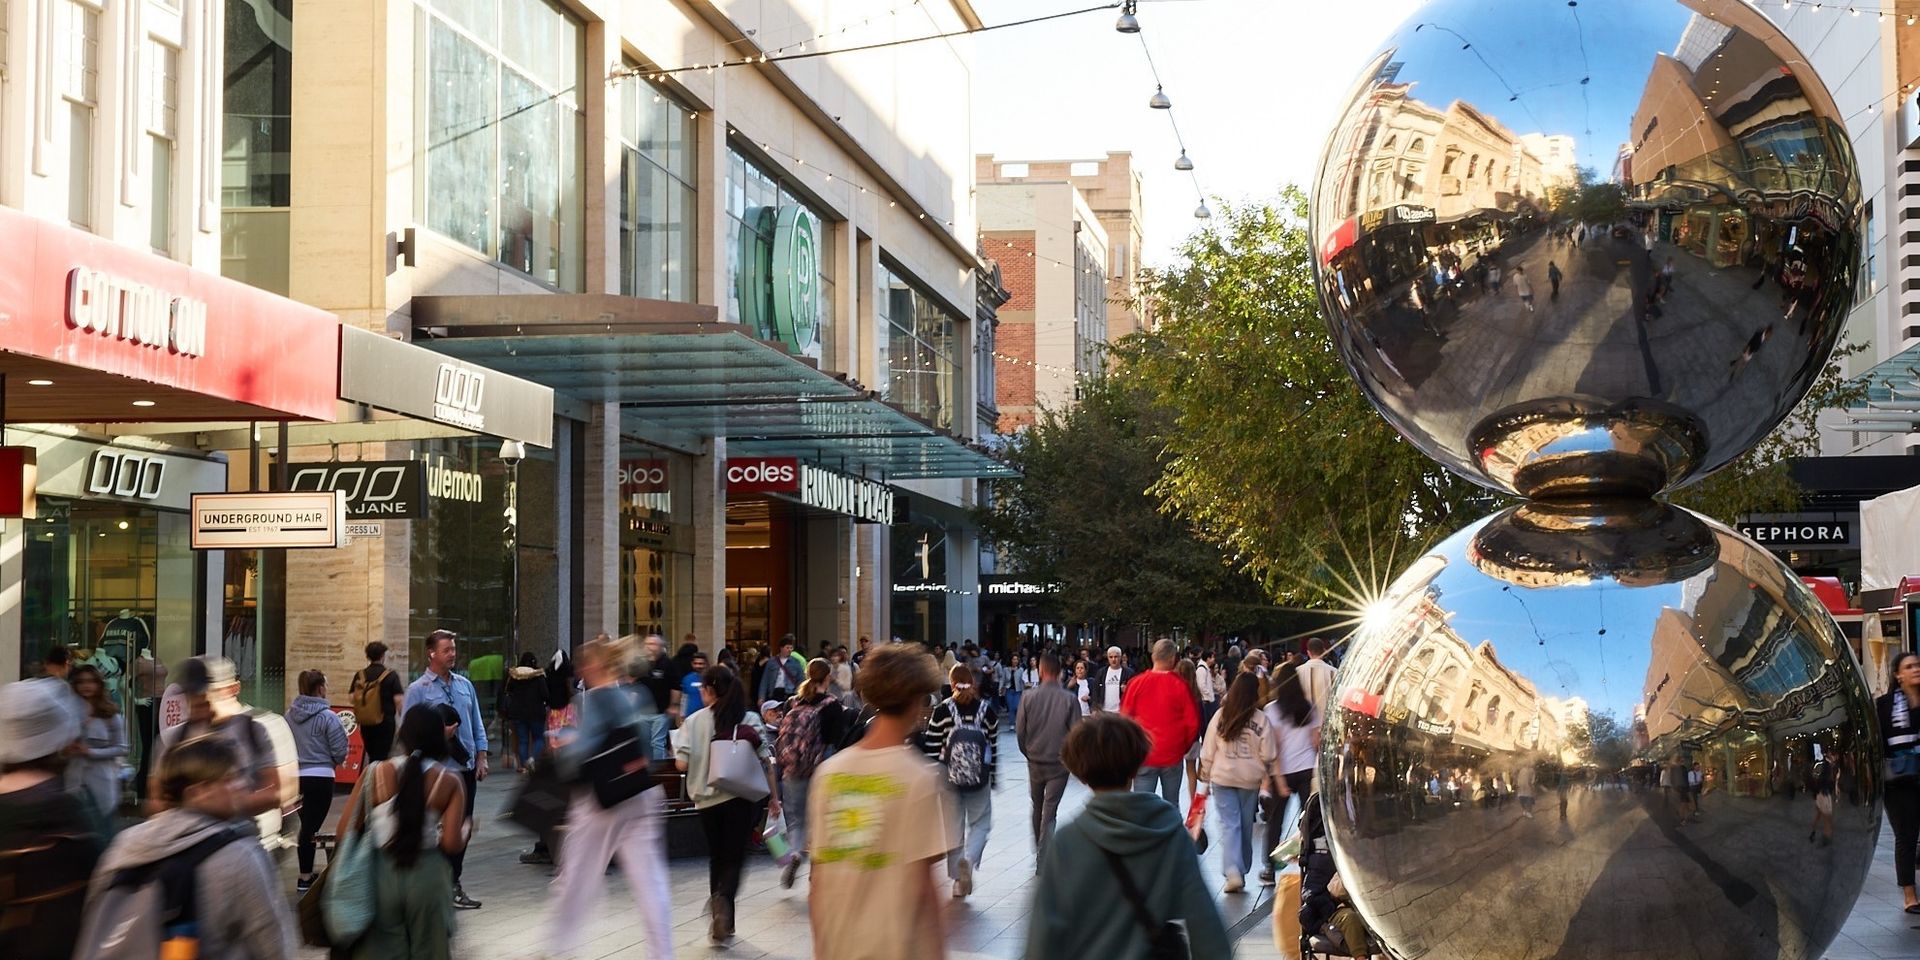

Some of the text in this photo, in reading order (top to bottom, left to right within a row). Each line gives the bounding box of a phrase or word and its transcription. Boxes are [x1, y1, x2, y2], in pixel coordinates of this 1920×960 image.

[68, 265, 171, 349] COTTON
[727, 461, 795, 483] coles
[354, 501, 407, 514] JANE
[203, 512, 322, 525] UNDERGROUND HAIR
[248, 525, 261, 533] EST
[370, 525, 379, 535] LN
[1742, 526, 1845, 541] SEPHORA
[166, 713, 181, 726] OFF
